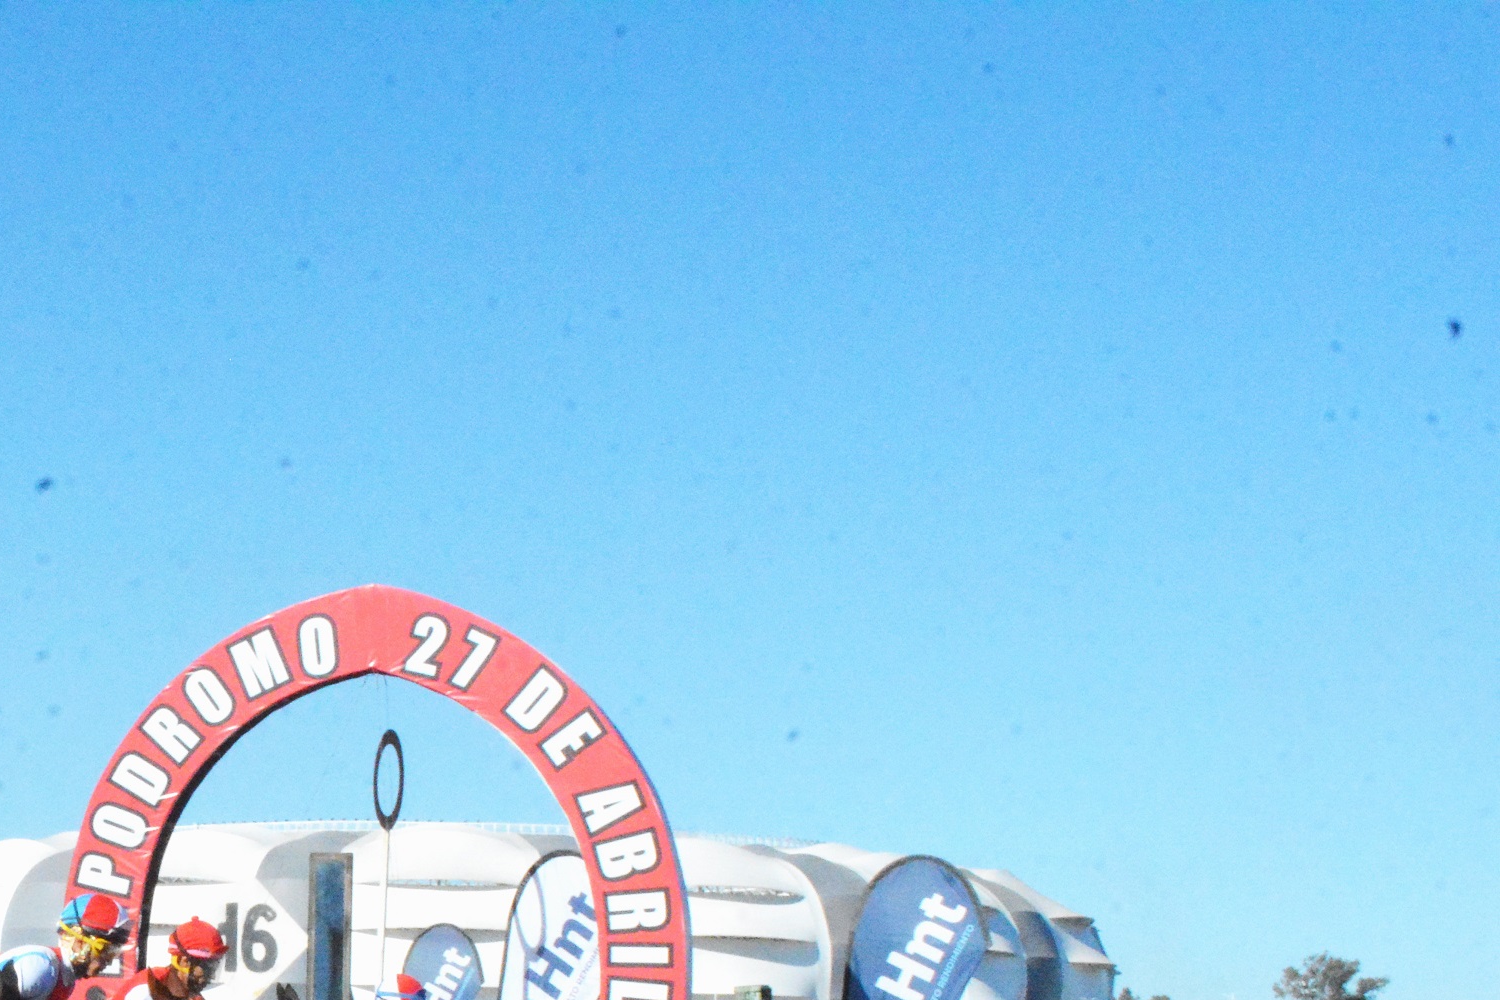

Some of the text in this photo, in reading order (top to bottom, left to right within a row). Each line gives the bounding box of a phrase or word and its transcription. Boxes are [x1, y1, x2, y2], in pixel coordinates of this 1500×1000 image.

[401, 612, 501, 692] 27
[501, 663, 608, 772] DE
[940, 923, 975, 989] RENDIMIENTO
